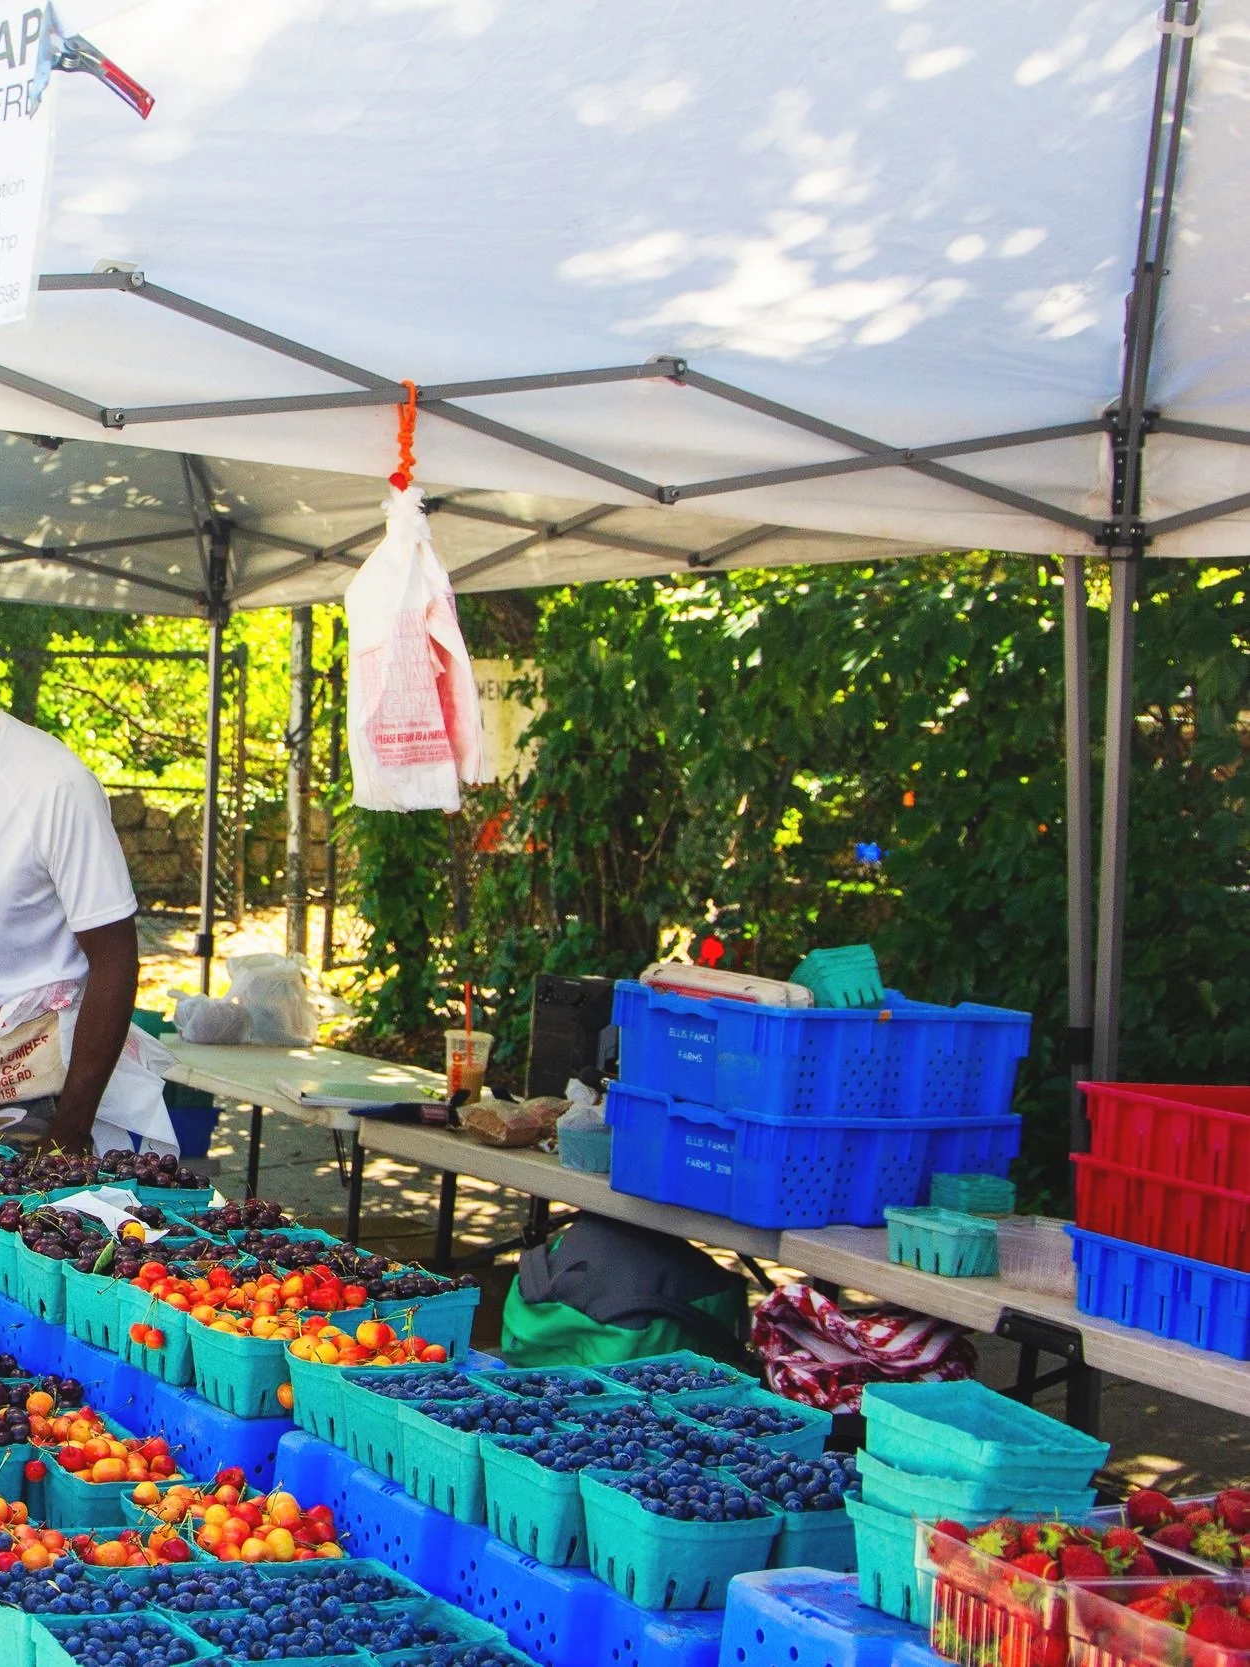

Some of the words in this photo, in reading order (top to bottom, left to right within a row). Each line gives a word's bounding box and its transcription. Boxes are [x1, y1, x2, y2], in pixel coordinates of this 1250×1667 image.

[669, 1027, 688, 1039] ELLIS
[689, 1030, 715, 1044] FAMILY
[678, 1049, 703, 1063] FARMS
[16, 1069, 36, 1081] RD.
[686, 1135, 704, 1148] ELLIS
[686, 1156, 711, 1171] FARMS
